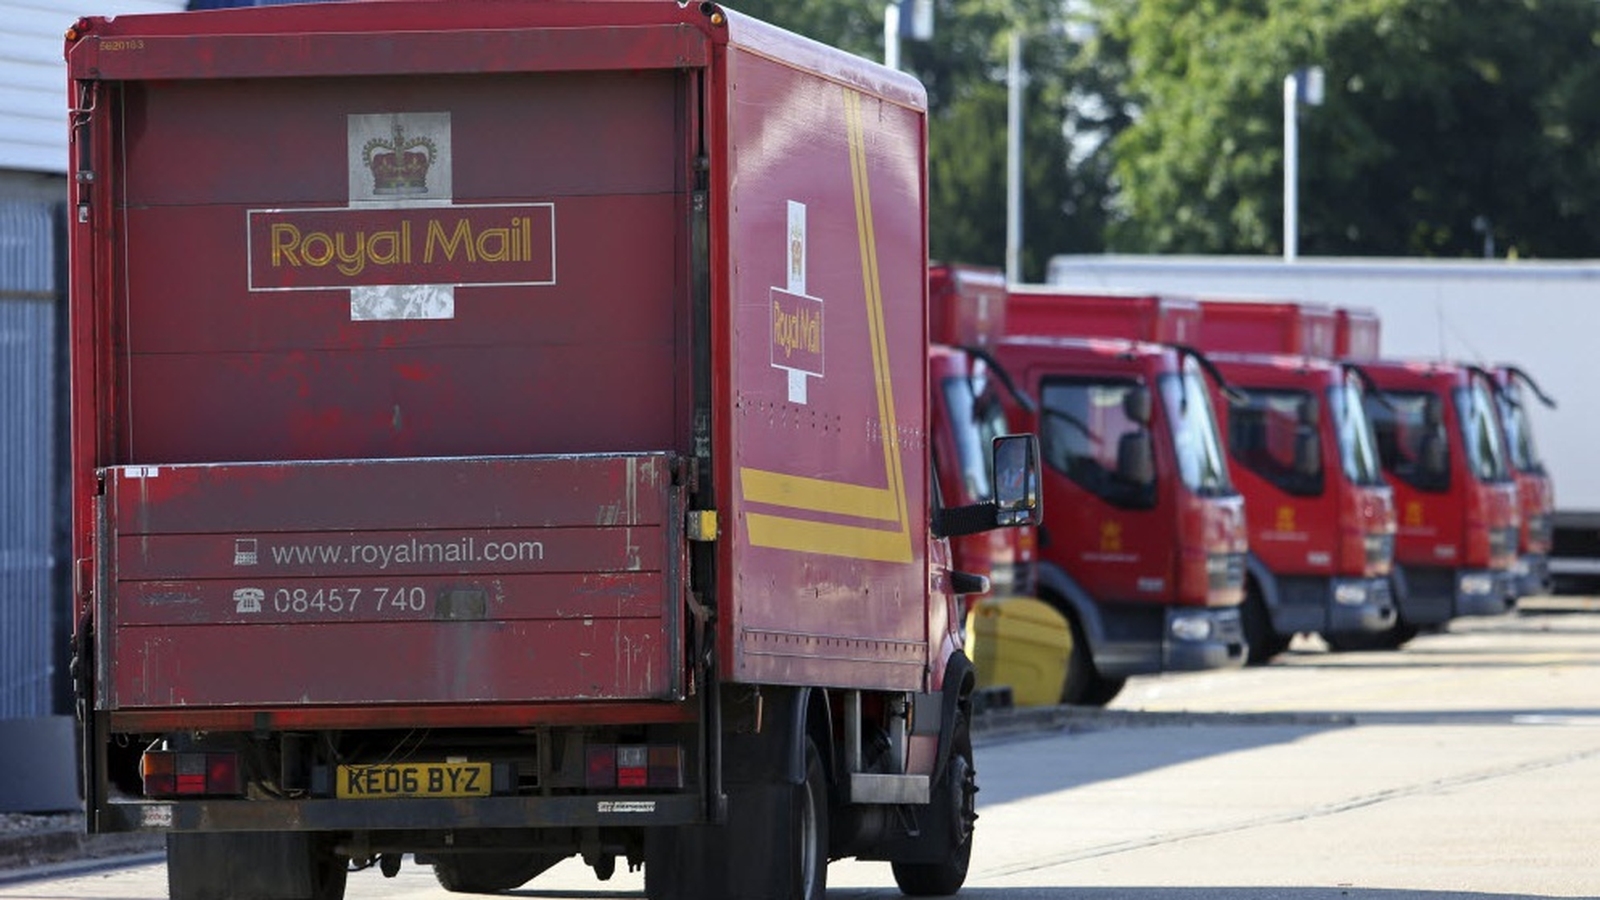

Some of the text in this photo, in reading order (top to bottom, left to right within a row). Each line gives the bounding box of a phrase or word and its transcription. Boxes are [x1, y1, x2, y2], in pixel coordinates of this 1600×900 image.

[272, 217, 531, 275] Royal Mail
[774, 300, 820, 358] Royal Mail
[272, 538, 543, 569] www.royalmail.com
[274, 587, 426, 613] 08457 740
[348, 767, 480, 794] KE06 BYZ
